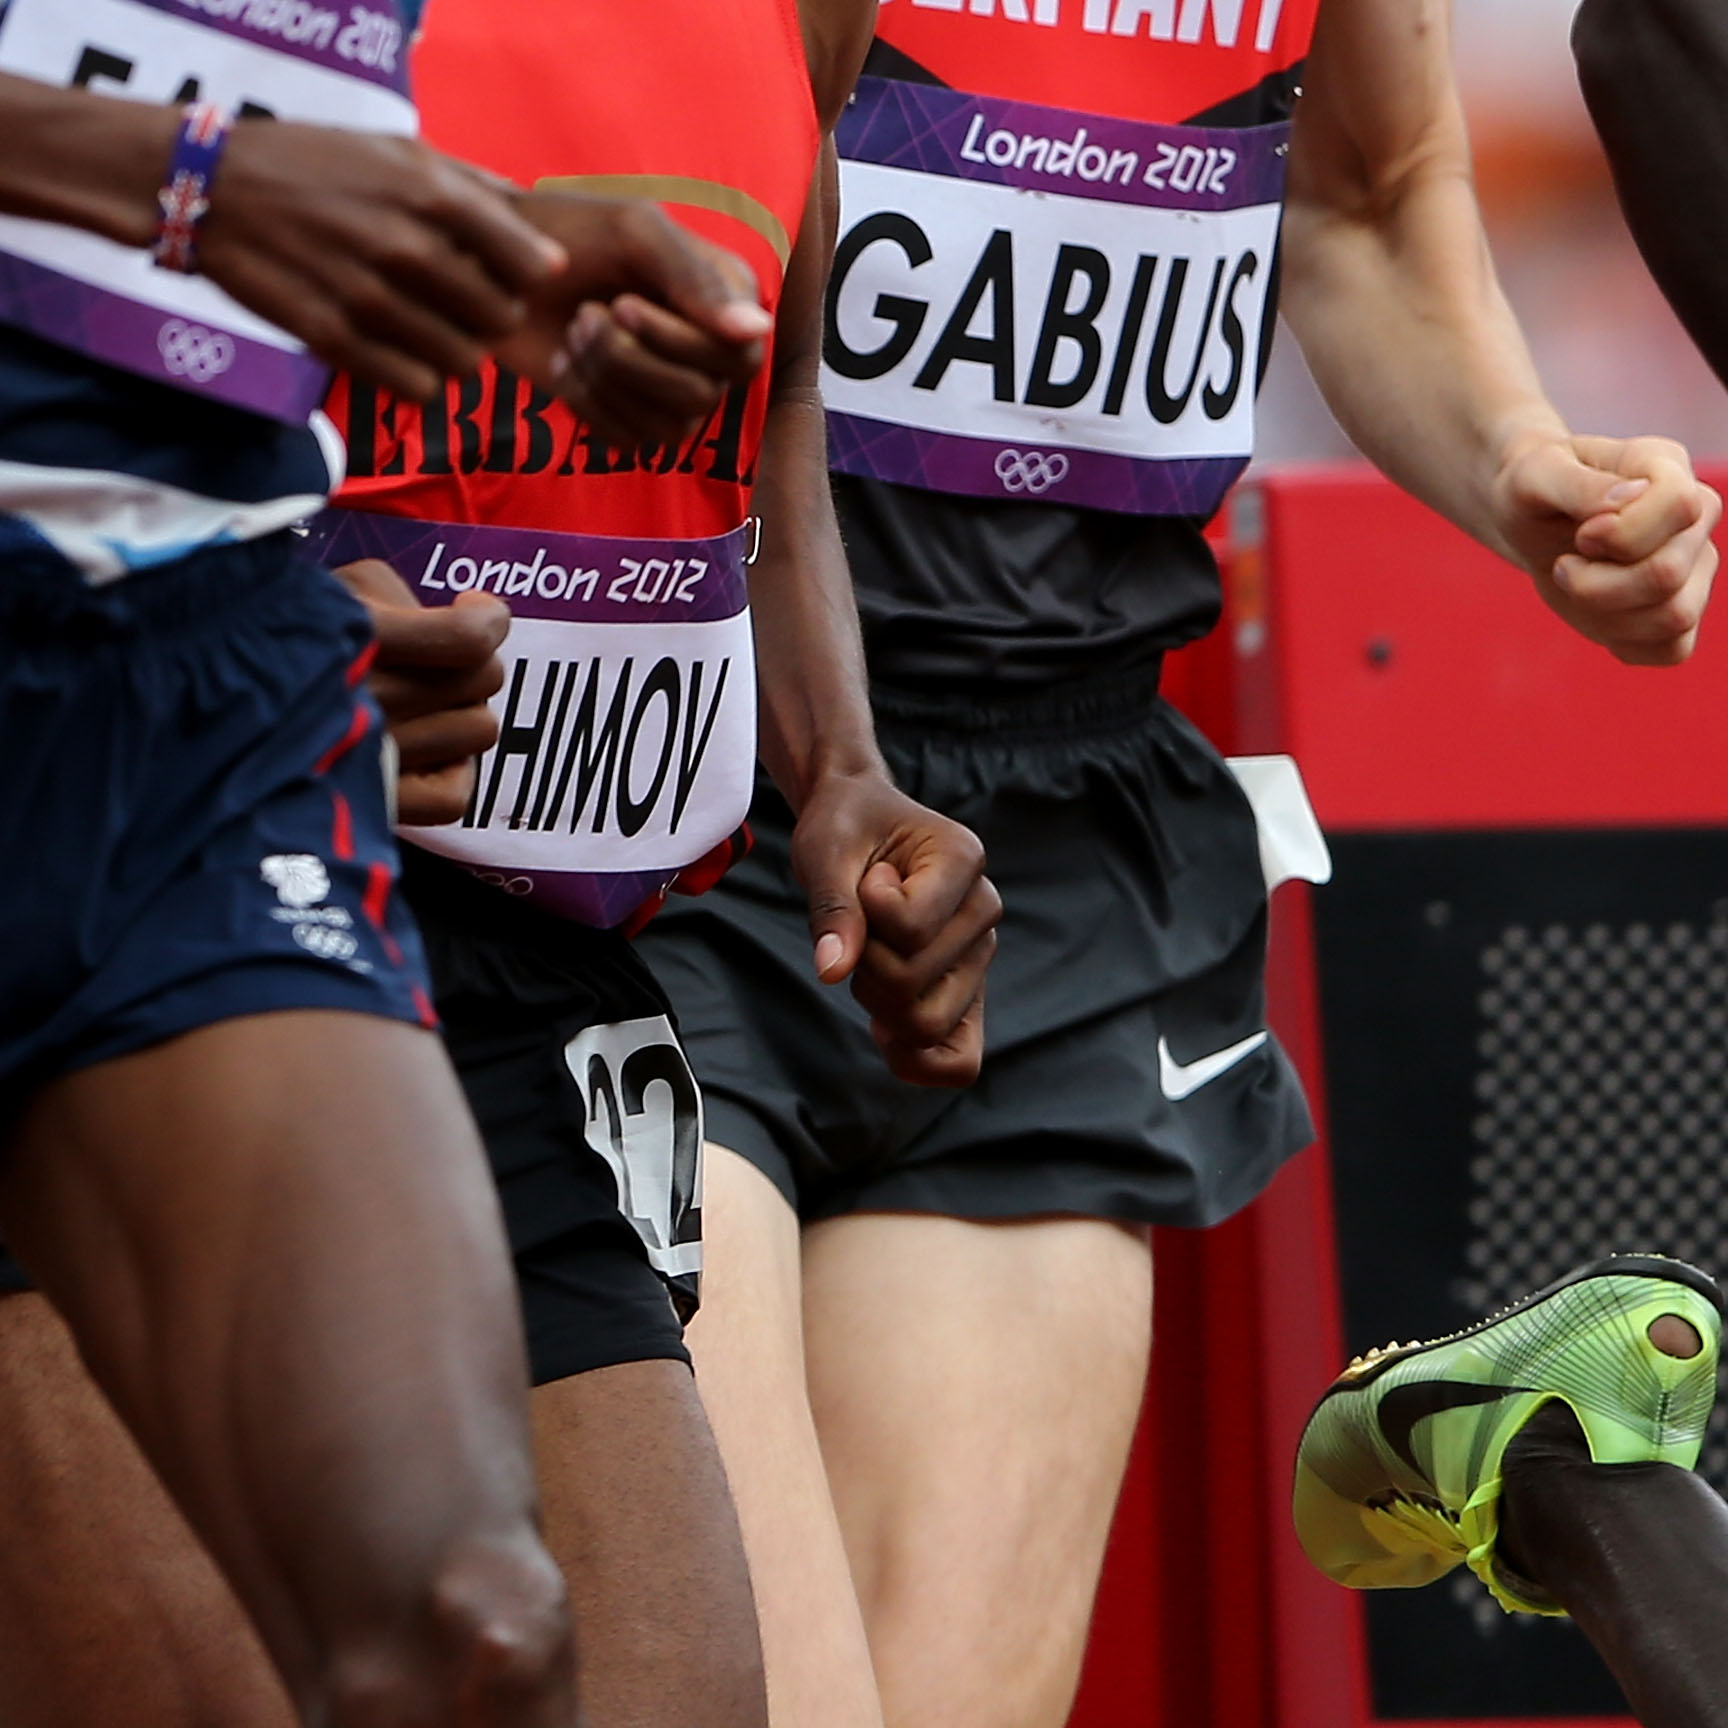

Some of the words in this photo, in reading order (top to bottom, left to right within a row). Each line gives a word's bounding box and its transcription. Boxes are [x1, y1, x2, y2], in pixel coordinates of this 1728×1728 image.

[960, 113, 1139, 187] London
[1143, 144, 1237, 195] 2012
[821, 212, 1259, 426] GABIUS
[420, 541, 599, 602] London
[607, 556, 709, 604] 2012
[462, 655, 731, 838] HIMOV
